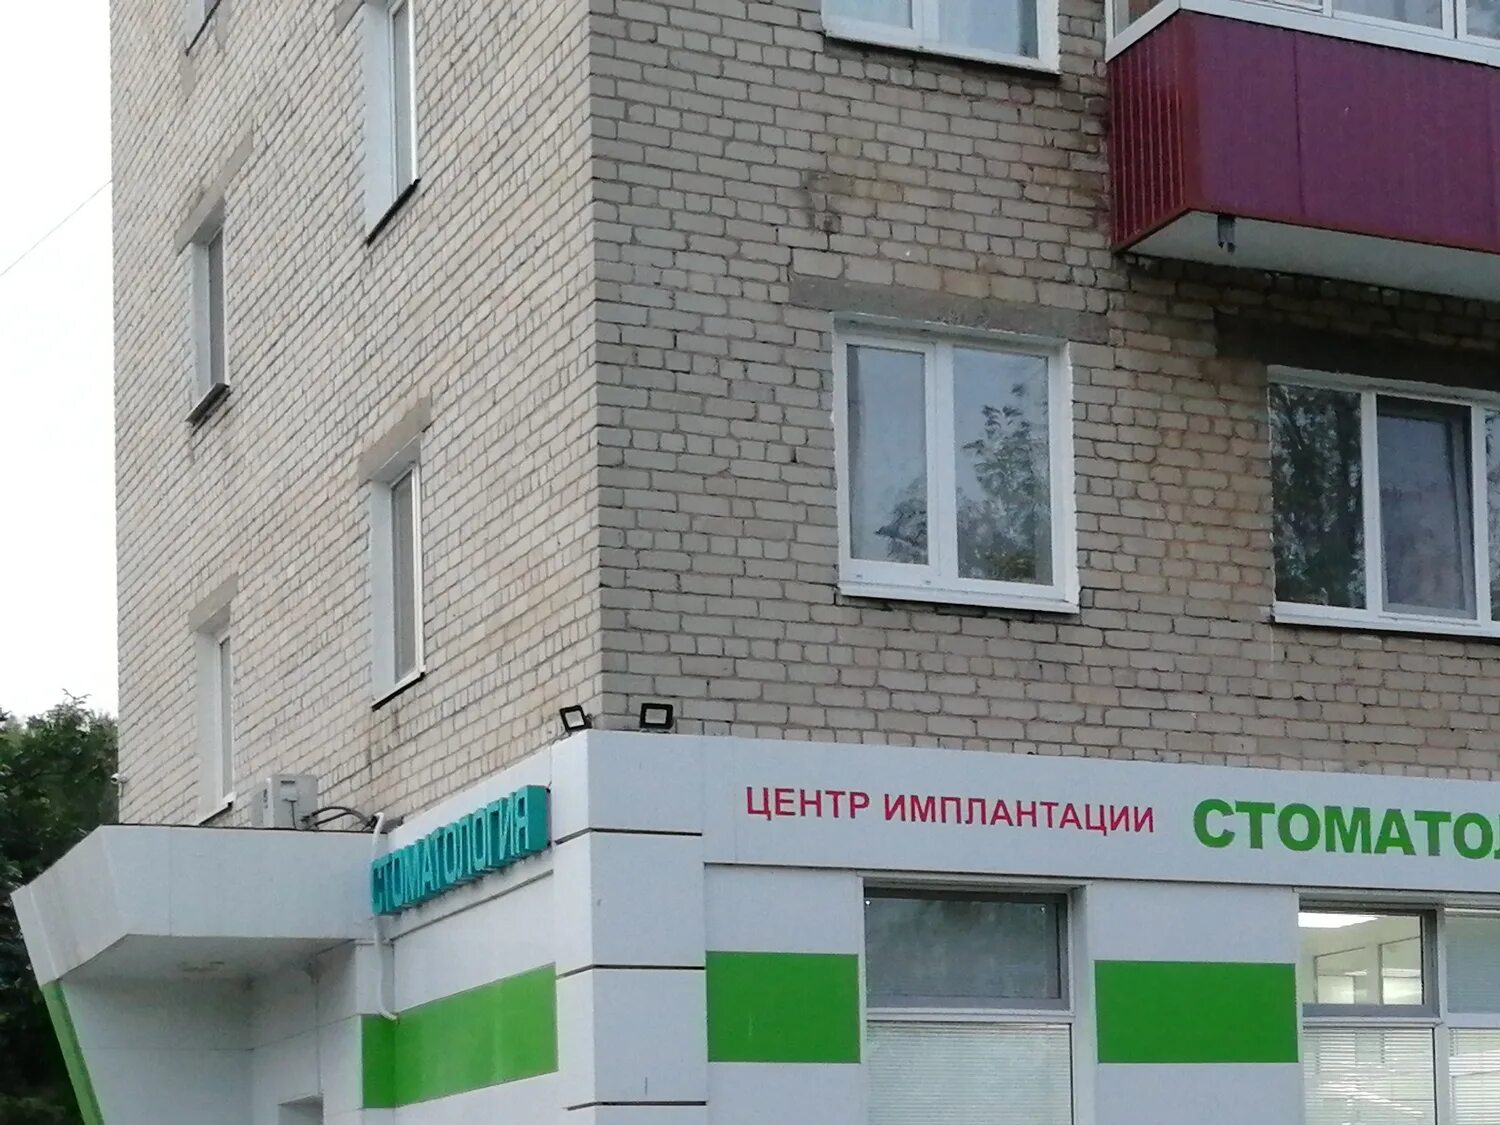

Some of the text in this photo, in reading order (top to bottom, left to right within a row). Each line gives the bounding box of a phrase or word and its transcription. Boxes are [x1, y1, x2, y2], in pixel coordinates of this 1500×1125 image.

[372, 784, 534, 916] СТОМАТОЛОГИЯ
[746, 786, 1155, 837] ЦЕНТР ИМПЛАНТАЦИИ
